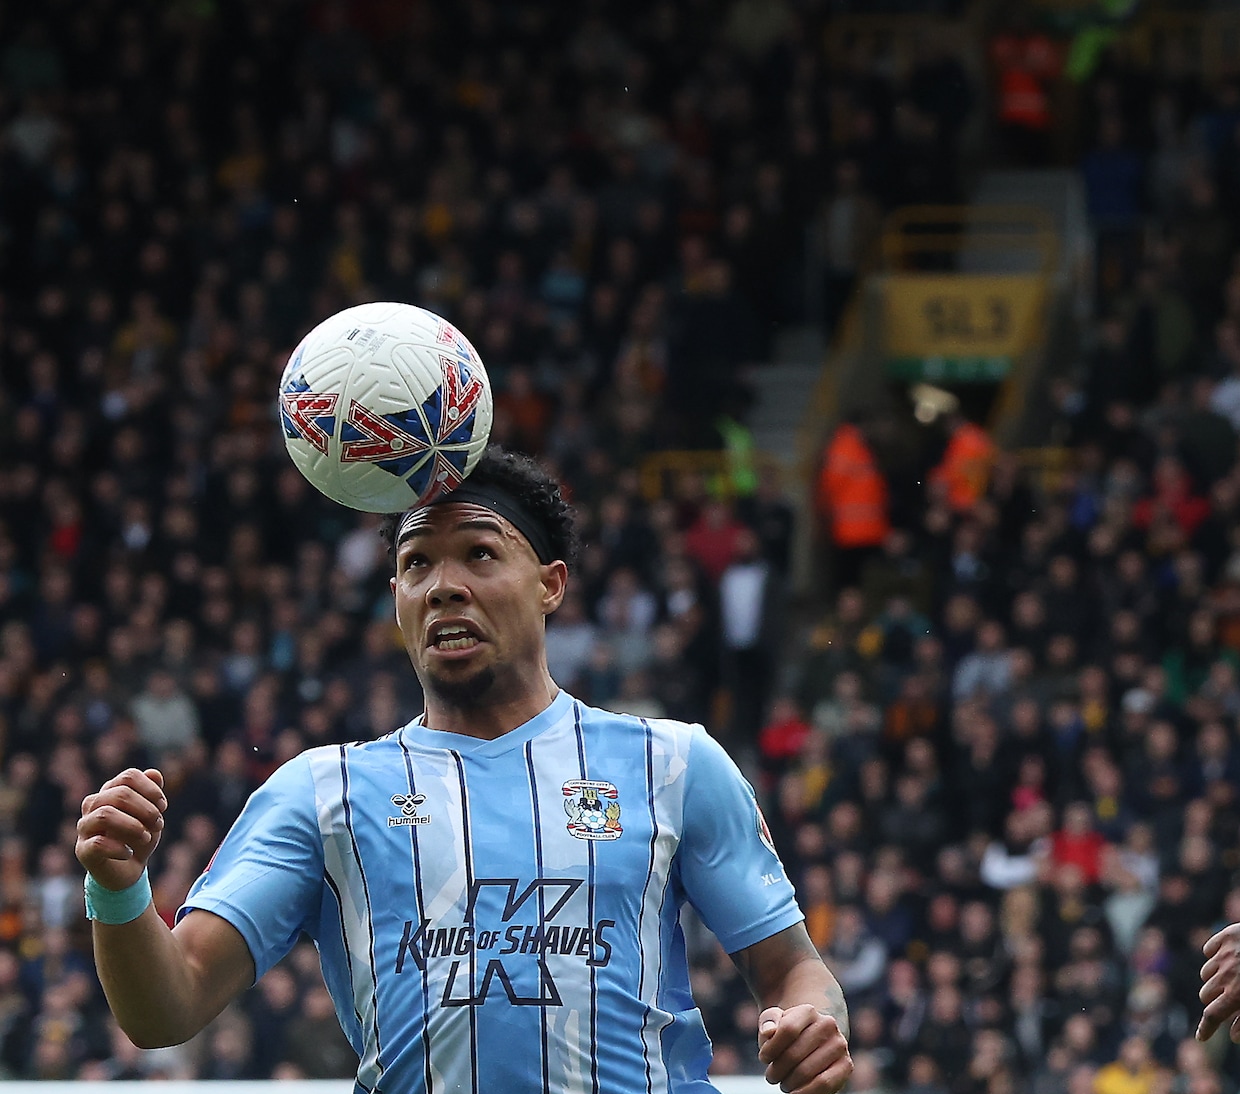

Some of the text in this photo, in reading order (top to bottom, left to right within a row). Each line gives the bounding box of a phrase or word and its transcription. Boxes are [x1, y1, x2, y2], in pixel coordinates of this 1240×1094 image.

[388, 815, 431, 827] hummel
[395, 919, 615, 974] KING OF SHAVES
